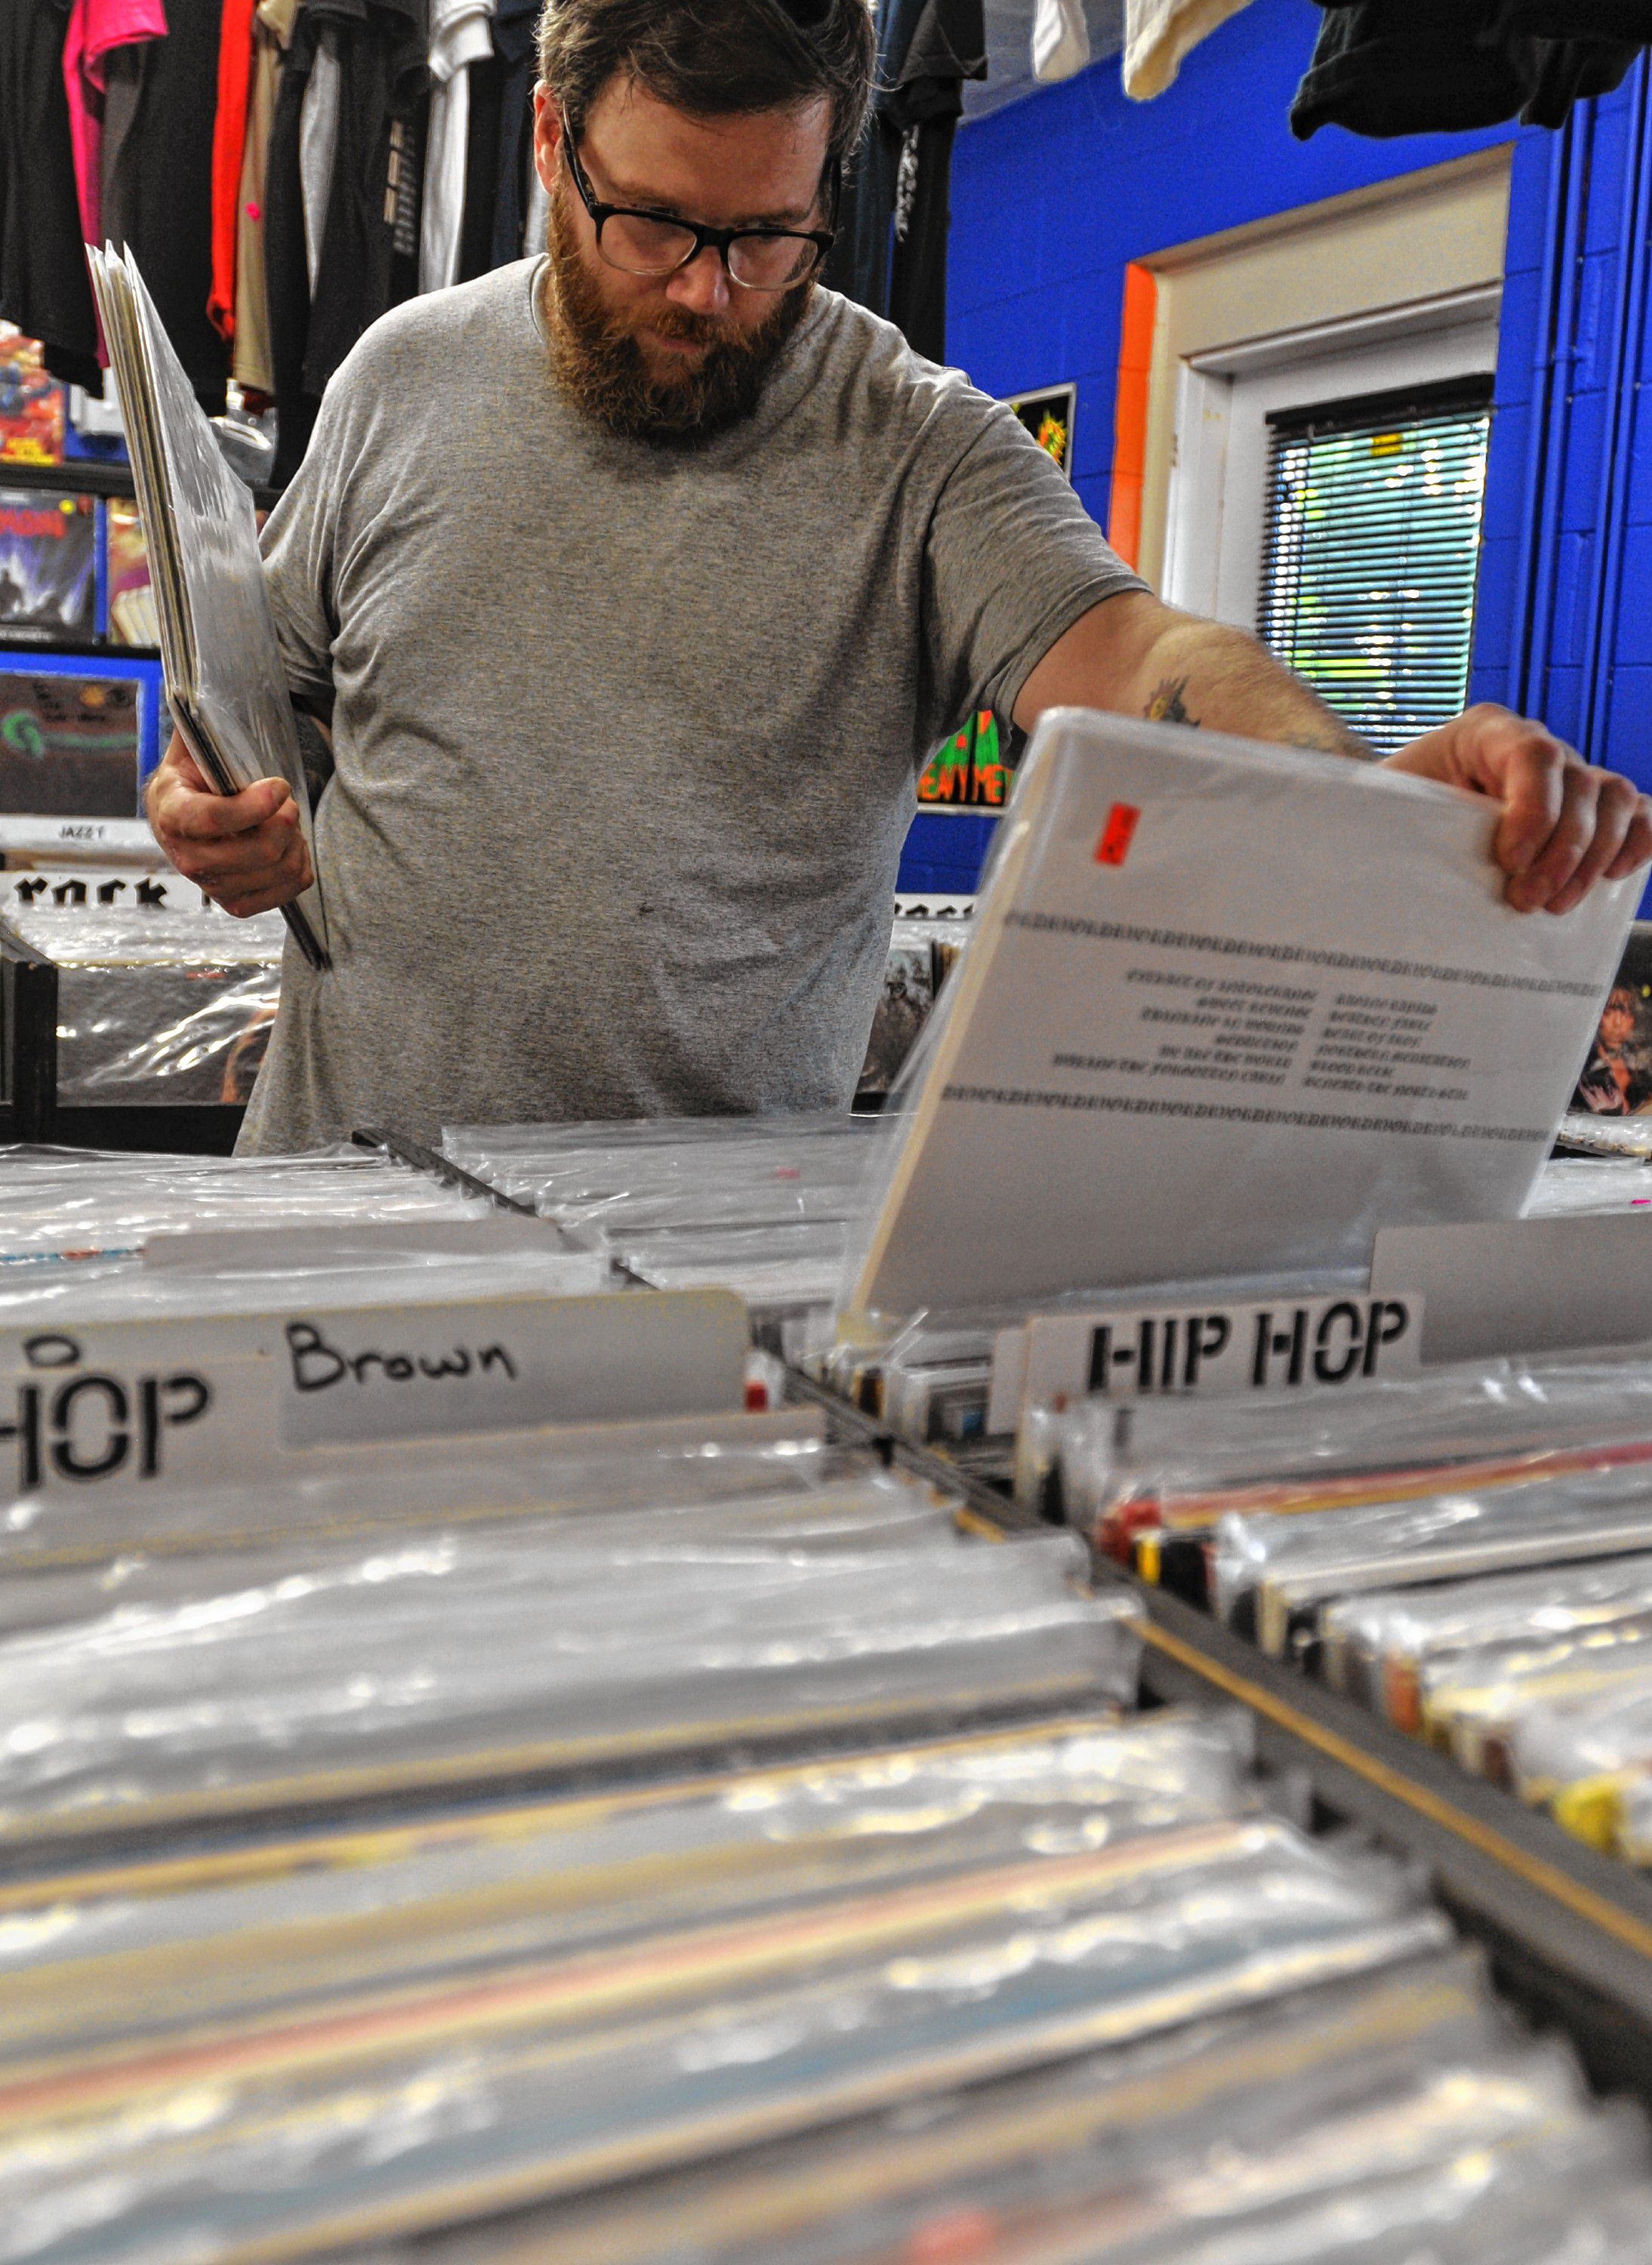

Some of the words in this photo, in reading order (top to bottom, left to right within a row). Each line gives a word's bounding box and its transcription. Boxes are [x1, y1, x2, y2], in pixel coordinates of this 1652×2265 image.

[916, 763, 969, 801] EAVY
[285, 1322, 516, 1392] Brown
[1088, 1314, 1231, 1392] HIP
[1251, 1301, 1410, 1385] HOP
[0, 1374, 210, 1488] HOP
